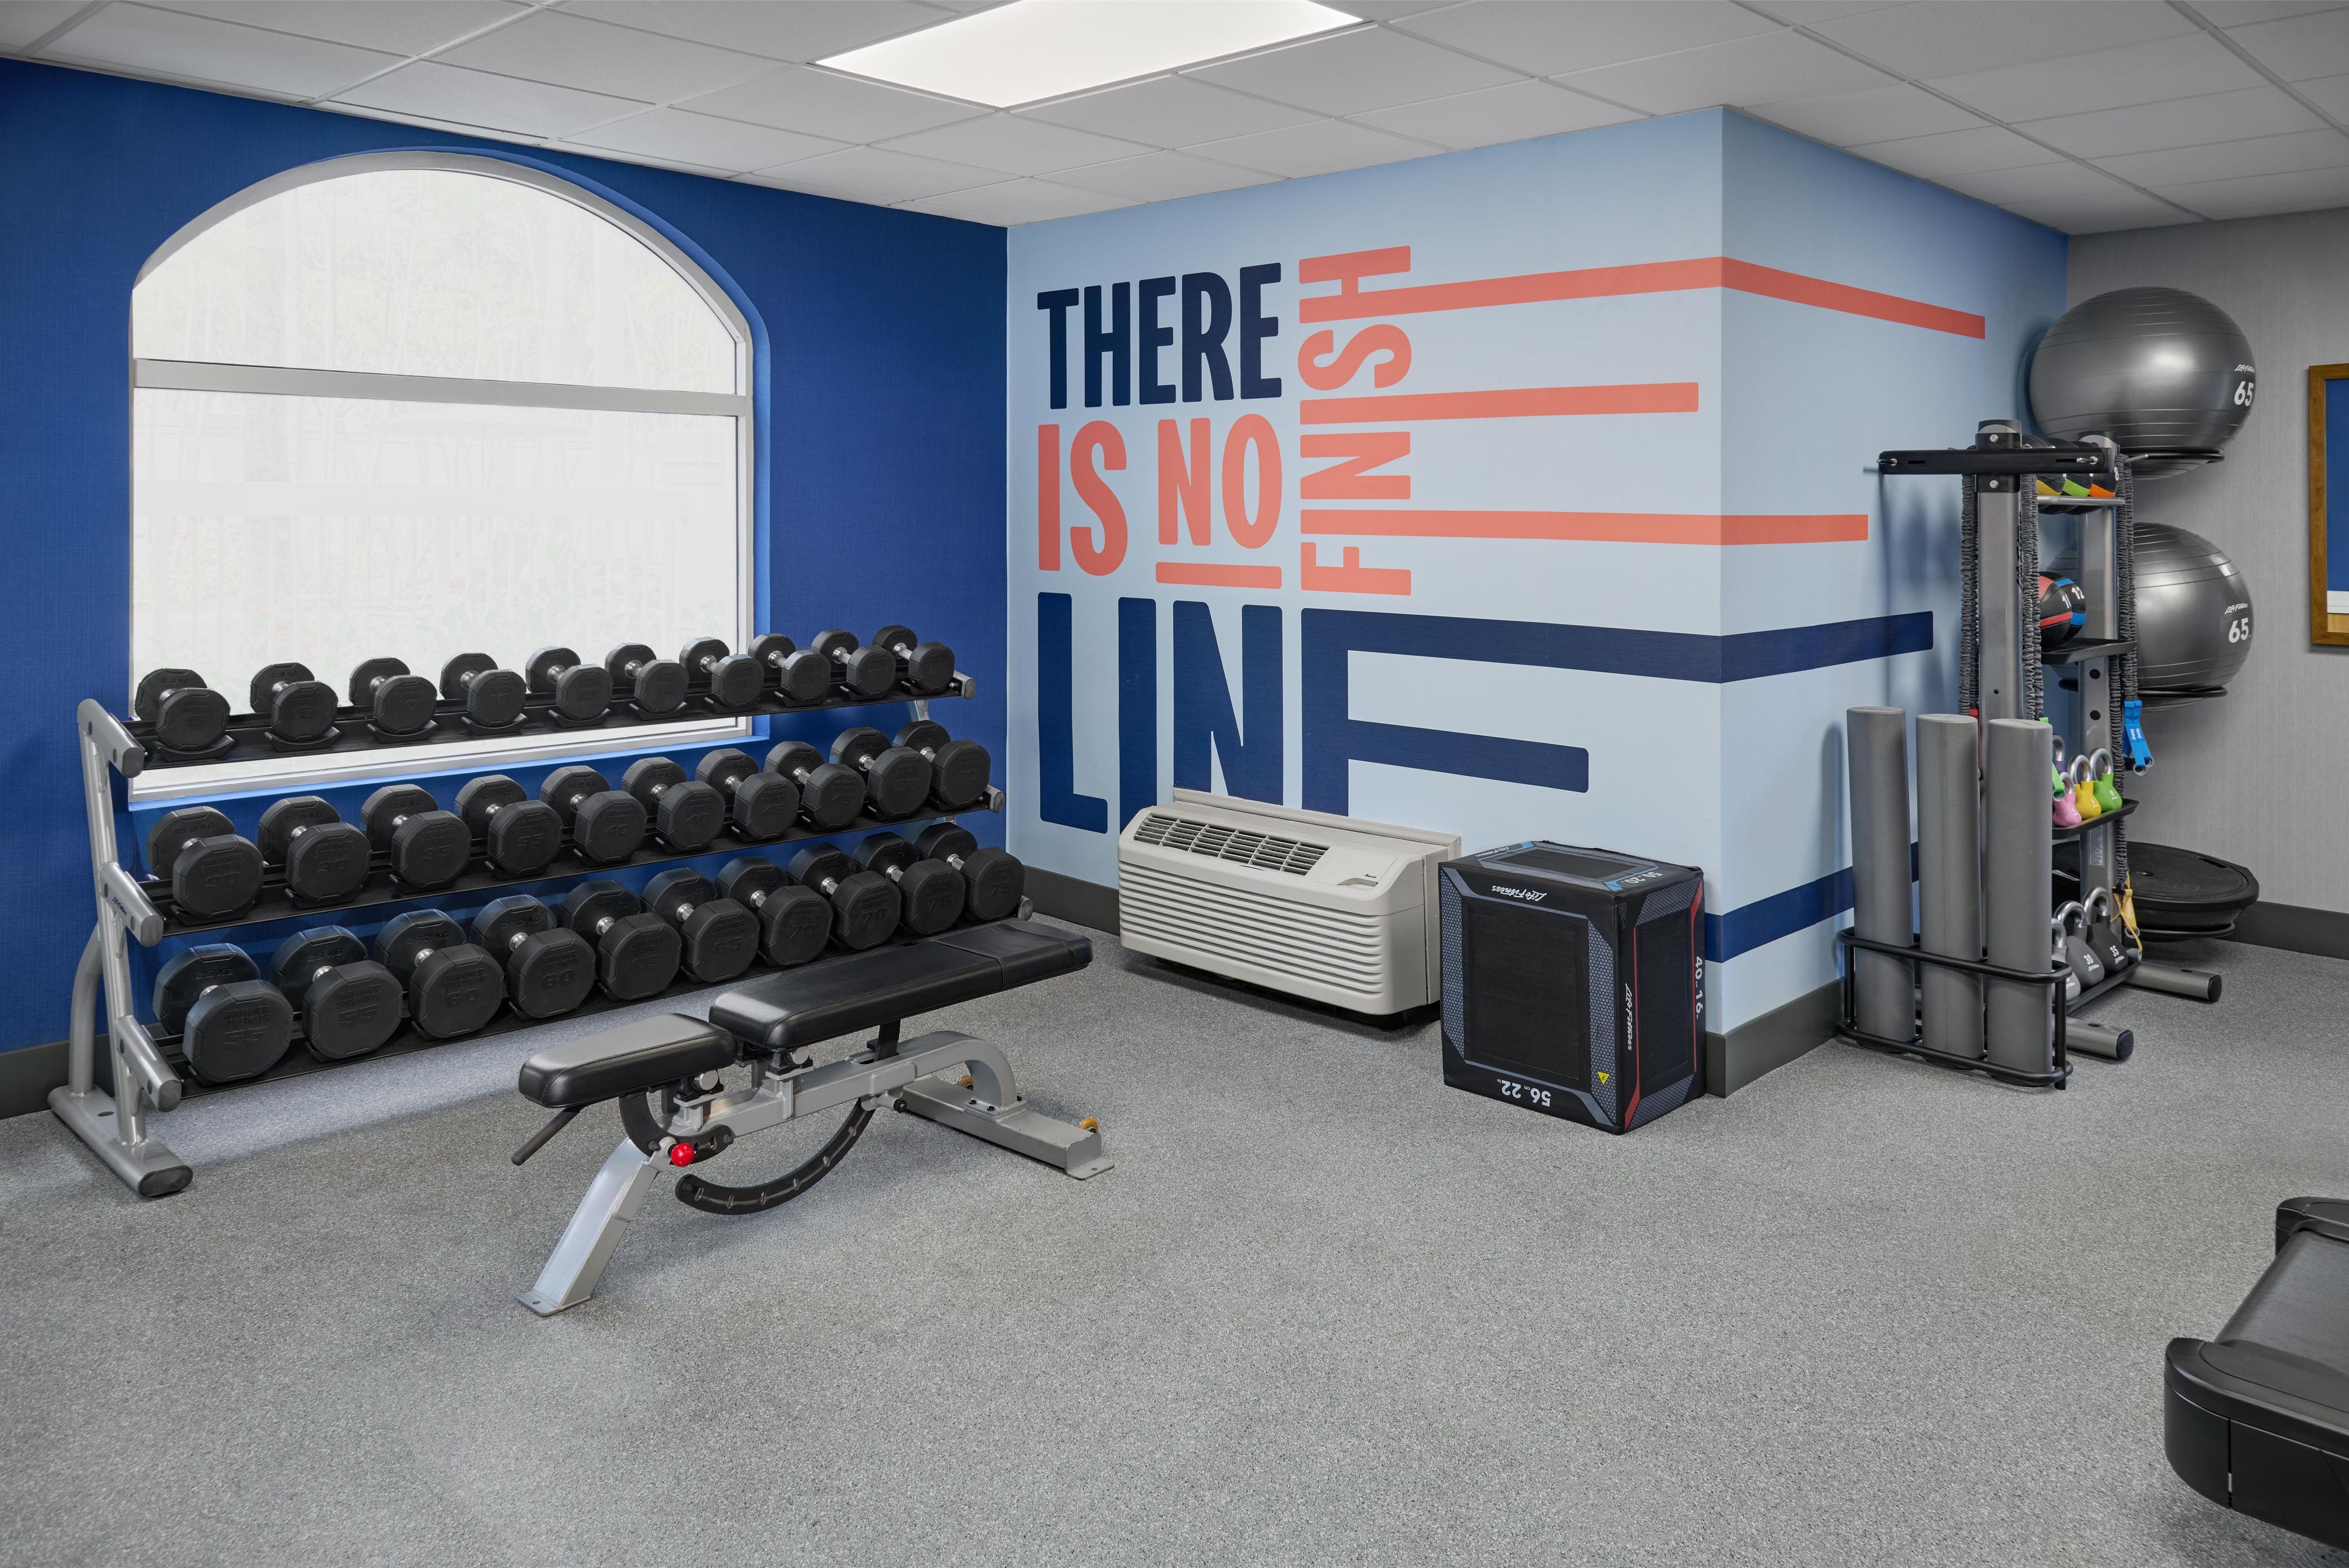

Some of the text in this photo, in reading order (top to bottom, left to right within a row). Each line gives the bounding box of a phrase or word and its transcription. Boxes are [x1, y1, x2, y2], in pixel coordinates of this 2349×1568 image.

[1037, 261, 1282, 410] THERE
[2234, 381, 2254, 407] 65
[1297, 245, 1412, 596] FINISH
[1038, 414, 1282, 576] IS NO
[2228, 617, 2249, 644] 65
[201, 822, 215, 831] KG
[1491, 885, 1547, 902] Life Fitness
[435, 932, 449, 940] KG
[327, 949, 343, 958] KG
[2084, 954, 2094, 965] 30
[2110, 945, 2120, 957] 35
[217, 968, 235, 977] KG
[1695, 956, 1703, 980] 40
[1696, 989, 1704, 1014] 16
[1501, 1080, 1521, 1099] 22
[1530, 1088, 1551, 1107] 56
